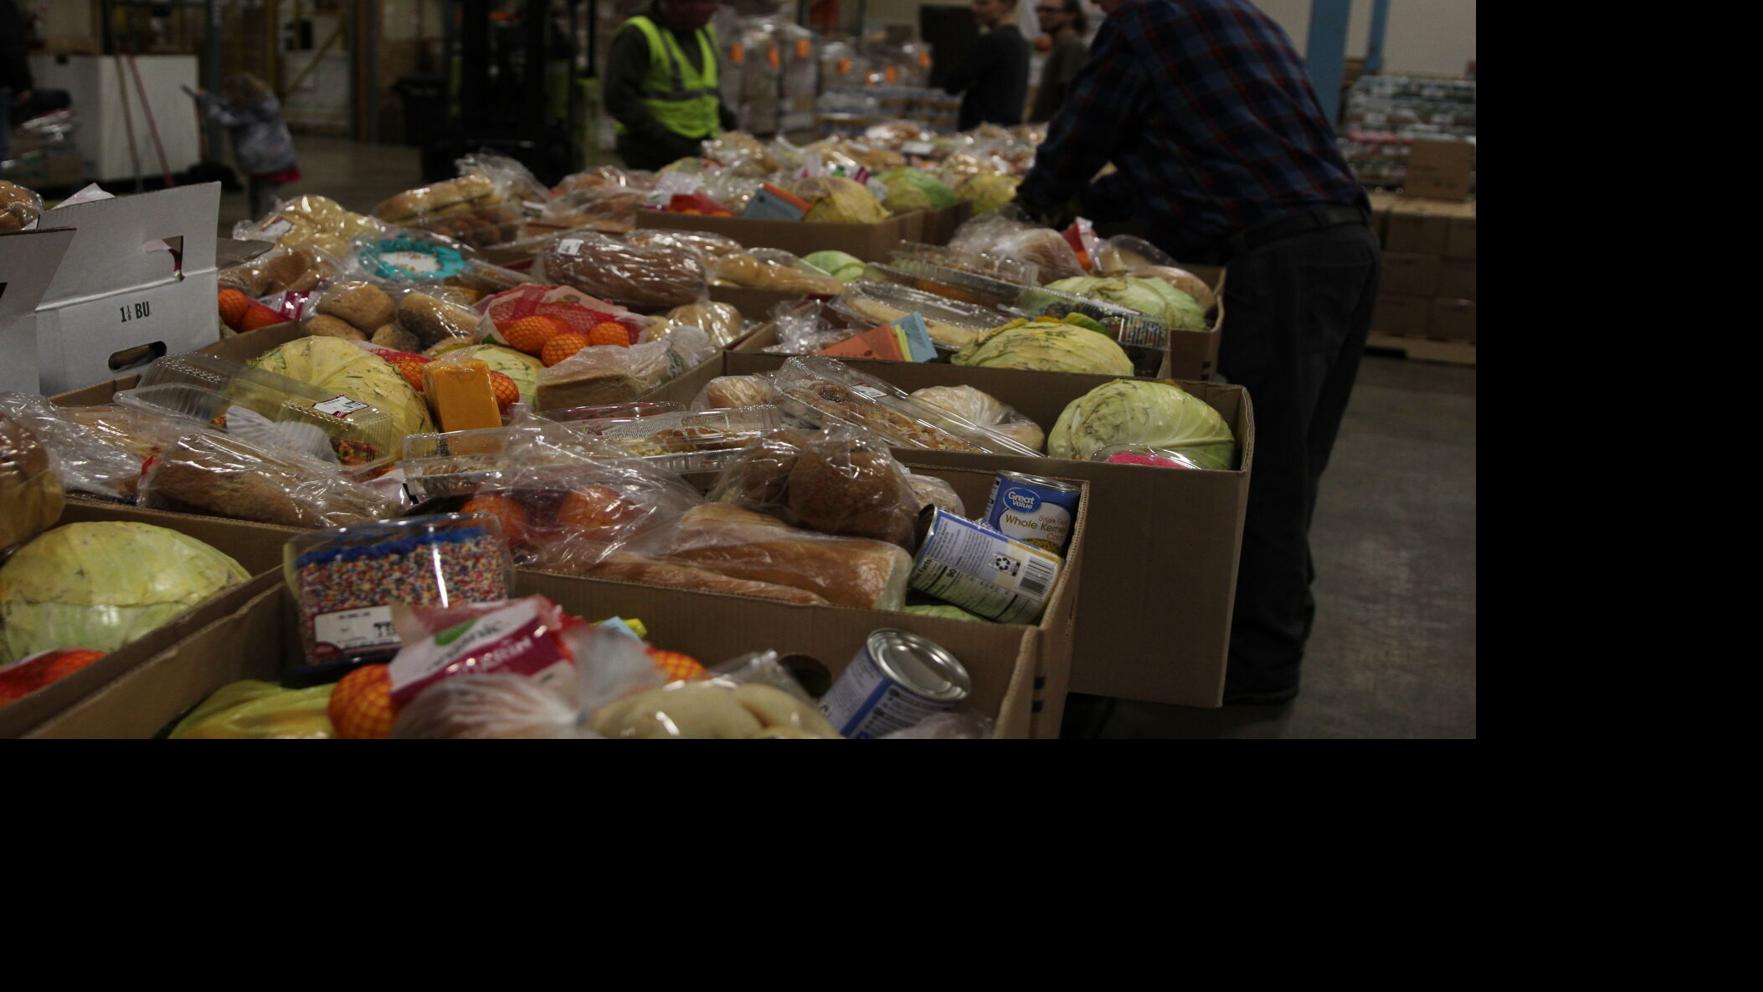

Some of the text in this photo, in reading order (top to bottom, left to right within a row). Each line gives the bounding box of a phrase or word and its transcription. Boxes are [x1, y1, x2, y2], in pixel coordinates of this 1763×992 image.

[135, 301, 150, 319] BU
[1008, 491, 1035, 505] Great
[1012, 500, 1033, 510] Value
[1005, 514, 1038, 530] Whole
